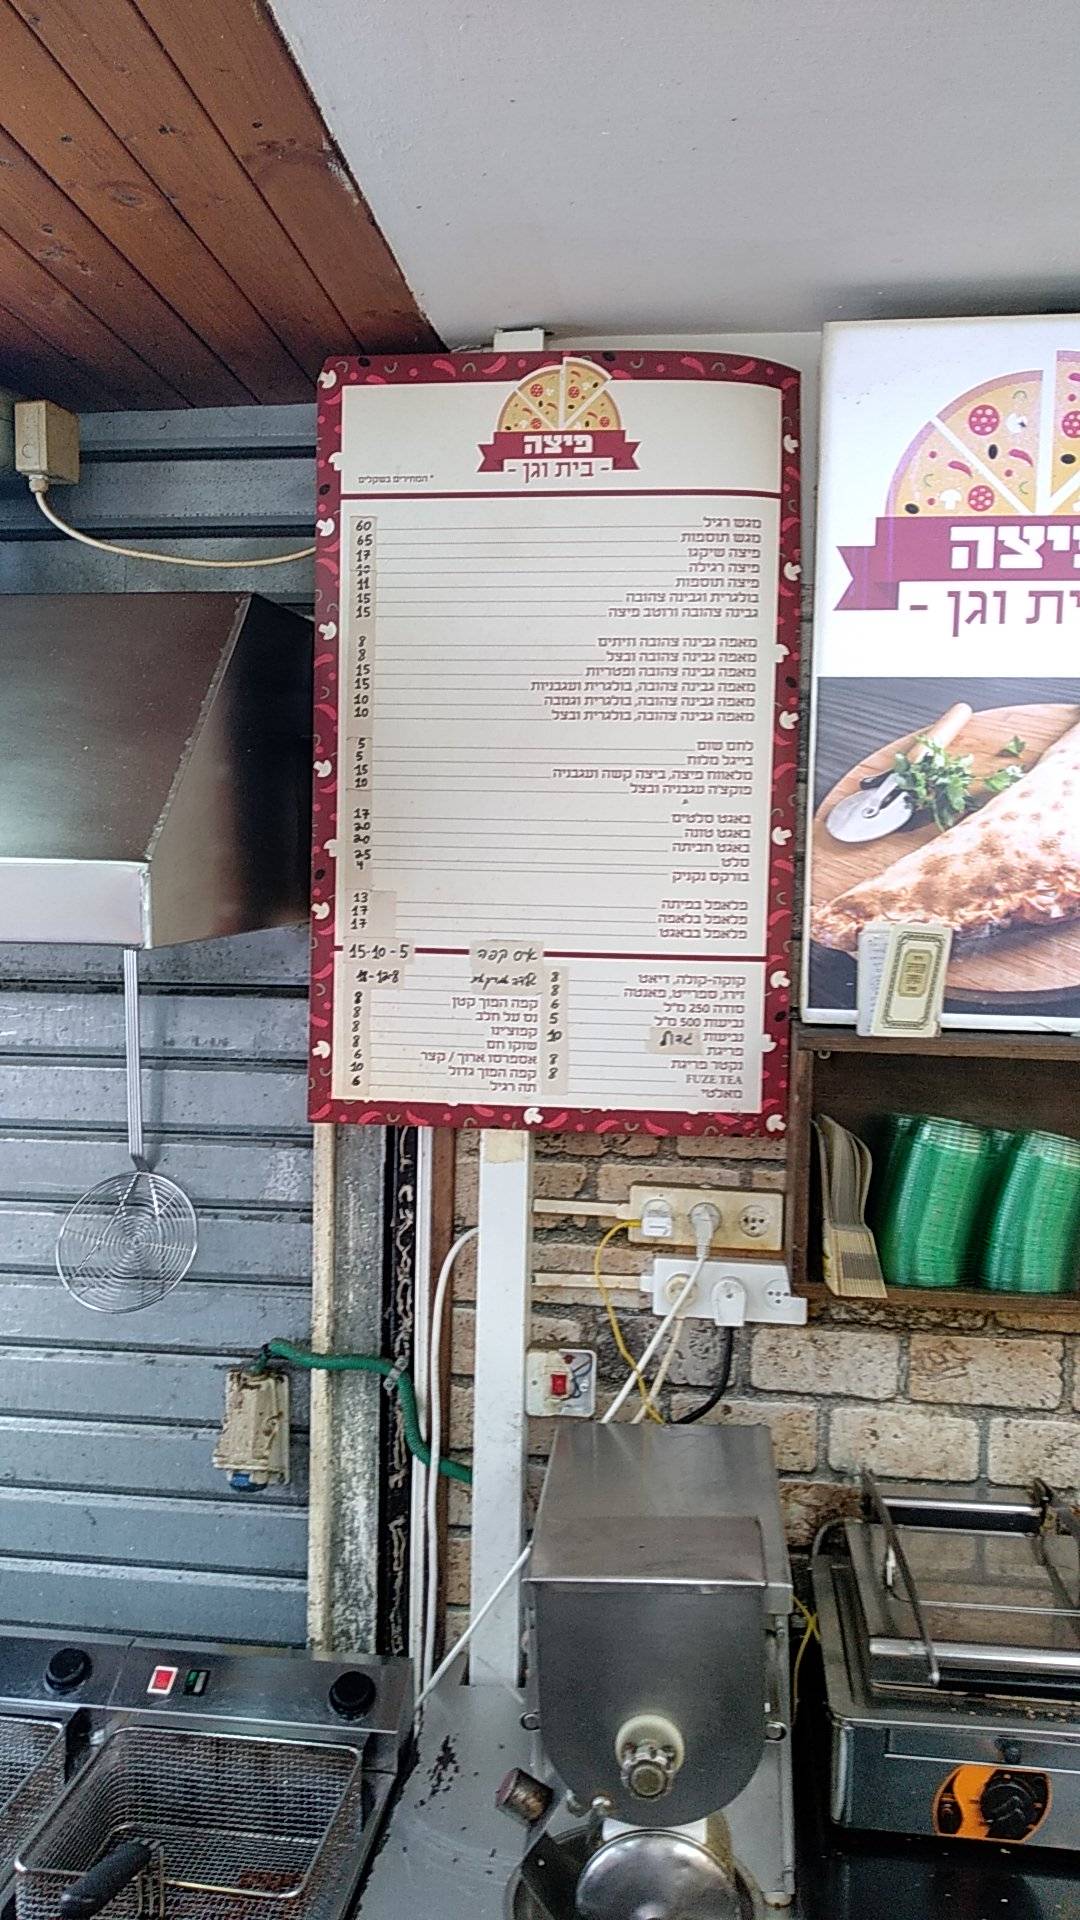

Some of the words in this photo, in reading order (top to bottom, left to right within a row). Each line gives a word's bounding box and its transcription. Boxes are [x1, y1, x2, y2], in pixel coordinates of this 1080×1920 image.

[523, 433, 593, 454] פיצה
[523, 462, 549, 483] וגן
[554, 461, 594, 478] בית
[355, 520, 372, 531] 60
[703, 516, 731, 529] רגיל
[733, 517, 761, 529] מגש
[356, 534, 372, 546] 65
[681, 532, 730, 544] תוספות
[733, 532, 761, 544] מגש
[728, 547, 761, 559] פיצה
[950, 525, 1080, 569] יצה
[356, 550, 370, 562] 17
[688, 547, 726, 560] שיקגו
[689, 562, 725, 573] רגילה
[728, 562, 760, 574] פיצה
[676, 577, 725, 589] תוספות
[727, 577, 760, 589] פיצה
[356, 593, 372, 604] 15
[626, 592, 666, 603] צהובה
[669, 592, 707, 604] וגבינה
[356, 606, 370, 618] 15
[609, 607, 640, 618] פיצה
[643, 607, 679, 618] ורוטב
[682, 607, 722, 619] צהובה
[725, 607, 758, 619] גבינה
[1026, 590, 1080, 625] ית
[947, 590, 1006, 638] וגן
[639, 637, 679, 648] צהובה
[683, 637, 716, 648] גבינה
[719, 637, 758, 648] מאפה
[605, 650, 636, 662] ובצל
[639, 650, 680, 662] צהובה
[682, 651, 716, 663] גבינה
[718, 651, 757, 663] מאפה
[356, 664, 370, 676] 15
[586, 666, 636, 678] ופטריות
[638, 666, 679, 678] צהובה
[681, 667, 716, 678] גבינה
[718, 667, 756, 678] מאפה
[354, 678, 370, 690] 15
[681, 682, 715, 693] גבינה
[717, 682, 756, 693] מאפה
[354, 694, 368, 704] 10
[681, 696, 715, 708] גבינה
[717, 696, 755, 708] מאפה
[354, 707, 368, 718] 10
[552, 709, 581, 721] ובצל
[680, 710, 714, 722] גבינה
[716, 711, 755, 723] מאפה
[358, 738, 366, 749] 5
[697, 740, 724, 752] שום
[726, 740, 754, 752] לחם
[356, 751, 363, 762] 5
[687, 755, 720, 766] מלוח
[354, 764, 368, 776] 15
[602, 769, 632, 781] קשה
[635, 769, 666, 780] ביצה
[354, 778, 368, 788] 10
[630, 783, 660, 794] ובצל
[662, 784, 705, 795] עגבניה
[354, 808, 370, 820] 17
[672, 813, 715, 825] סלטים
[717, 814, 751, 826] באגט
[354, 822, 370, 832] 20
[353, 834, 370, 844] 20
[684, 828, 714, 839] טונה
[716, 829, 751, 840] באגט
[672, 842, 714, 854] חביתה
[716, 844, 750, 854] באגט
[354, 849, 372, 860] 25
[356, 861, 364, 870] 4
[721, 858, 750, 869] סלט
[672, 871, 707, 884] נקניק
[709, 872, 749, 885] בורקס
[353, 892, 368, 902] 13
[352, 905, 368, 916] 17
[662, 900, 702, 911] בפיתה
[704, 901, 748, 912] פלאפל
[350, 918, 367, 930] 17
[658, 914, 701, 925] בלאפה
[703, 915, 748, 926] פלאפל
[660, 928, 701, 939] בבאגט
[703, 929, 747, 940] פלאפל
[453, 996, 476, 1010] קטן
[478, 997, 508, 1010] הפוך
[511, 998, 538, 1011] קפה
[550, 999, 560, 1010] 6
[689, 1003, 711, 1014] 250
[713, 1004, 745, 1014] סודה
[476, 1011, 501, 1022] חלב
[503, 1012, 520, 1022] על
[549, 1012, 559, 1024] 5
[680, 1016, 701, 1028] 500
[546, 1029, 562, 1042] 10
[487, 1040, 506, 1051] חם
[508, 1040, 537, 1053] שוקו
[354, 1048, 362, 1059] 6
[421, 1052, 446, 1063] קצר
[457, 1053, 485, 1065] ארוך
[488, 1054, 537, 1065] אספרסו
[350, 1062, 364, 1072] 10
[448, 1066, 475, 1077] גדול
[710, 1060, 743, 1072] נקטר
[477, 1067, 507, 1079] הפוך
[509, 1068, 537, 1080] קפה
[352, 1075, 361, 1086] 6
[489, 1080, 516, 1092] רגיל
[686, 1074, 717, 1085] FUZE
[720, 1075, 743, 1086] TEA
[518, 1082, 537, 1093] תה
